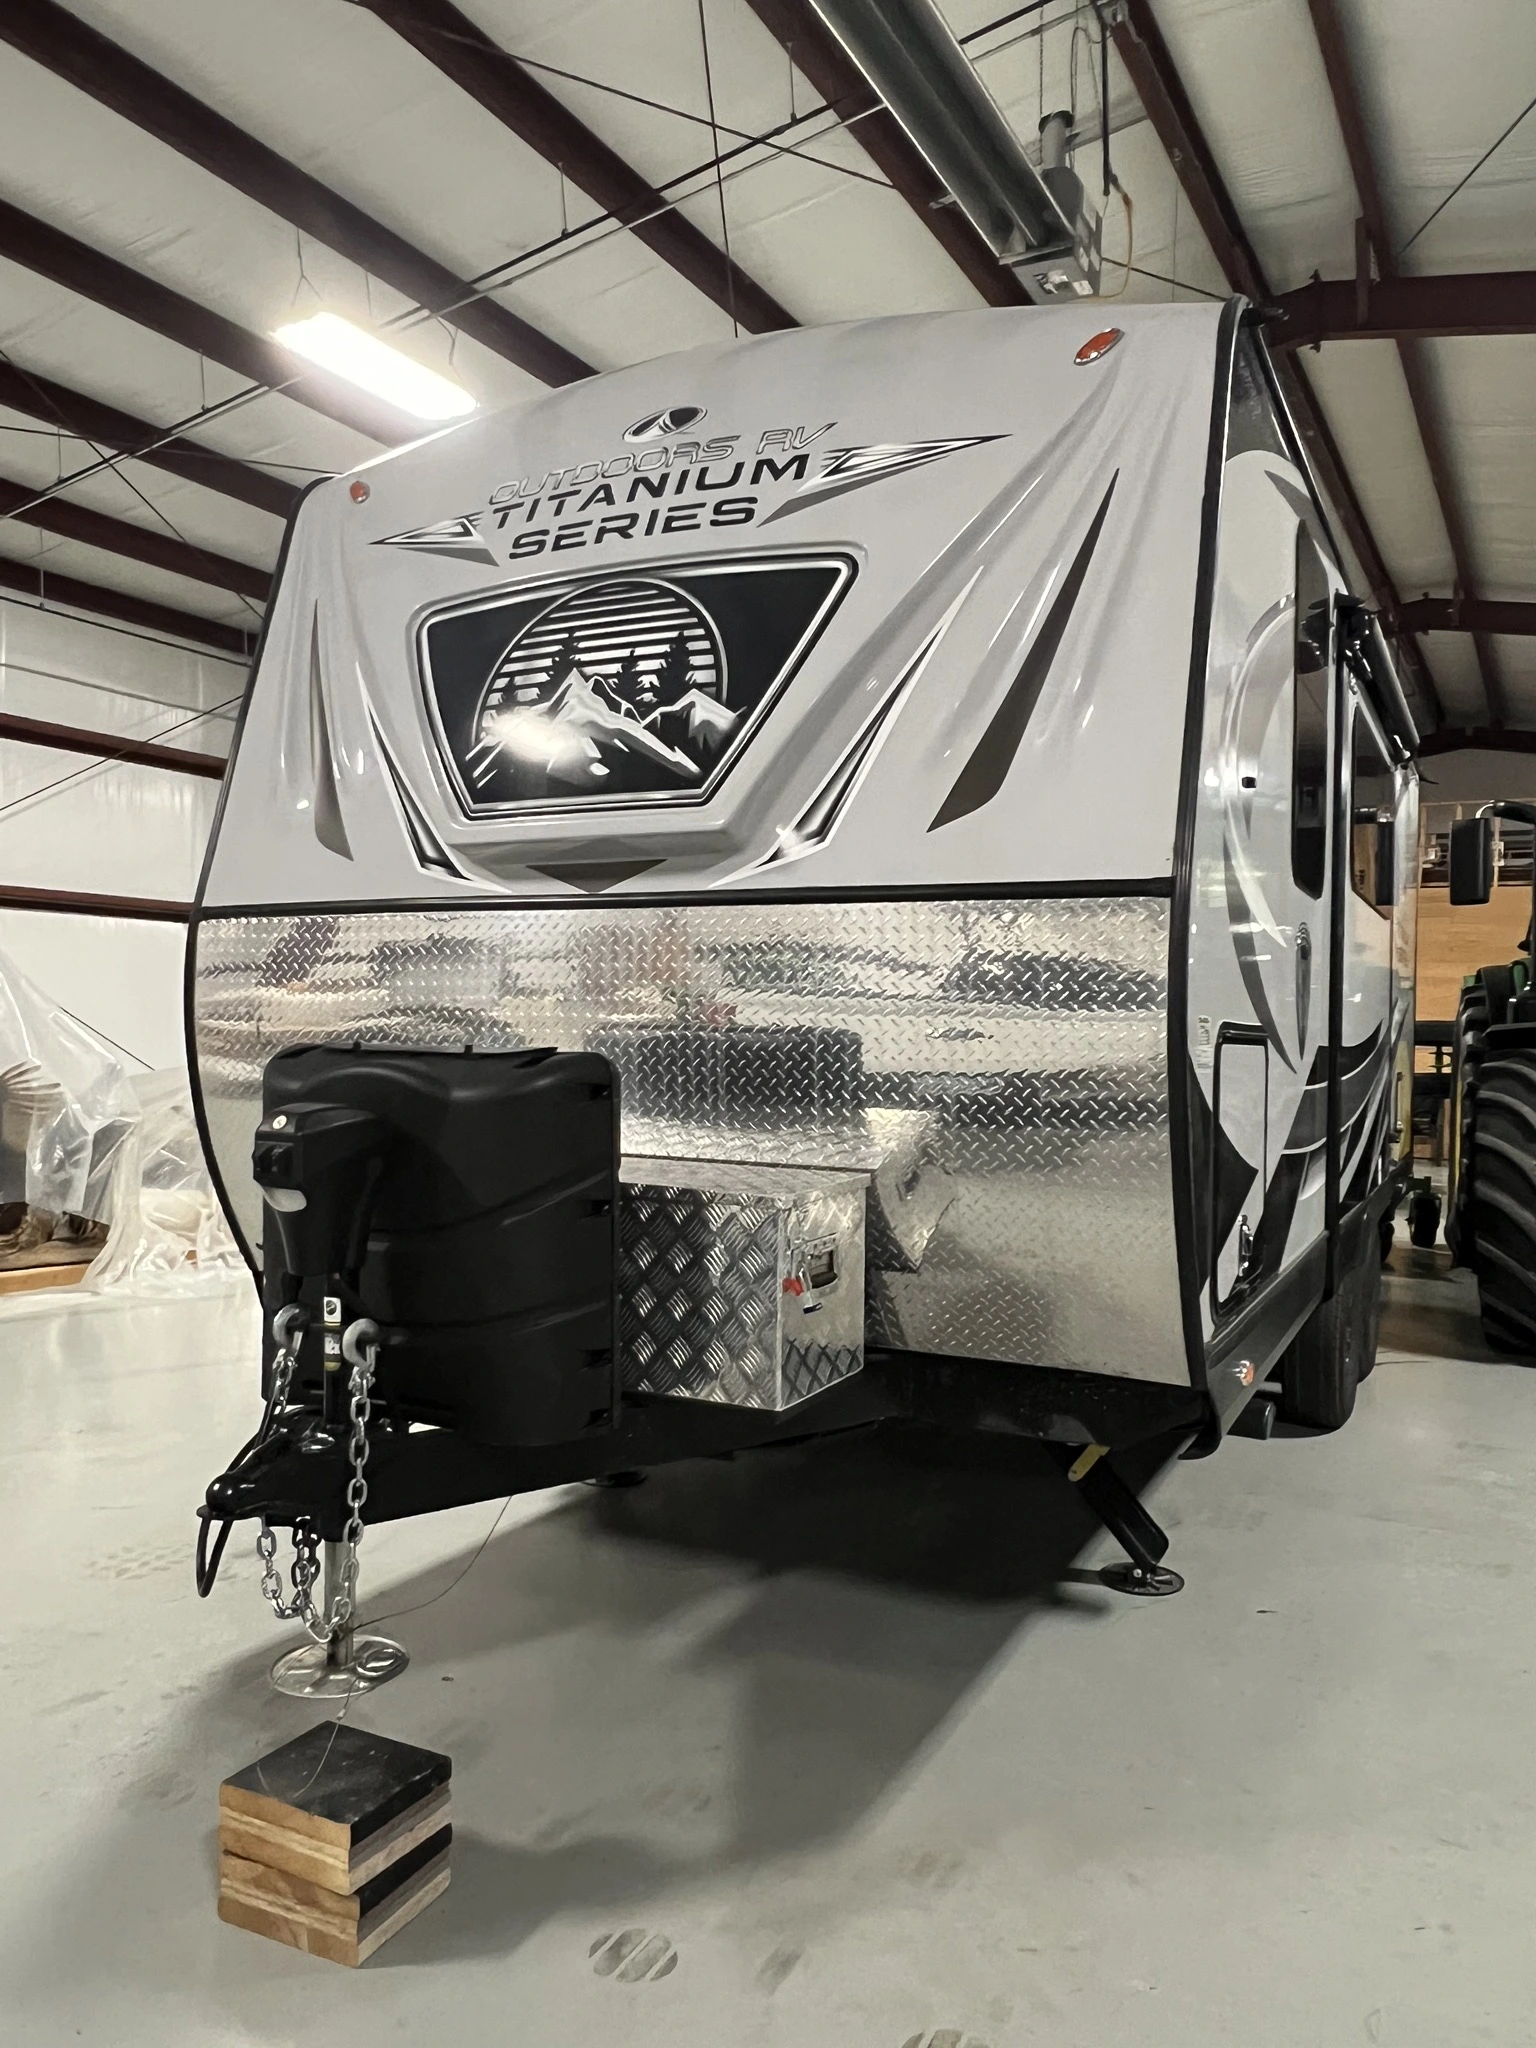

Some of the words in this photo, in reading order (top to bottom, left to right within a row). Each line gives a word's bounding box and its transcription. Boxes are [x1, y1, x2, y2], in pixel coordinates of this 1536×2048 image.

[488, 434, 741, 505] OUTDOORS
[755, 421, 838, 455] RV
[492, 453, 810, 529] TITANIUM
[509, 496, 758, 560] SERIES
